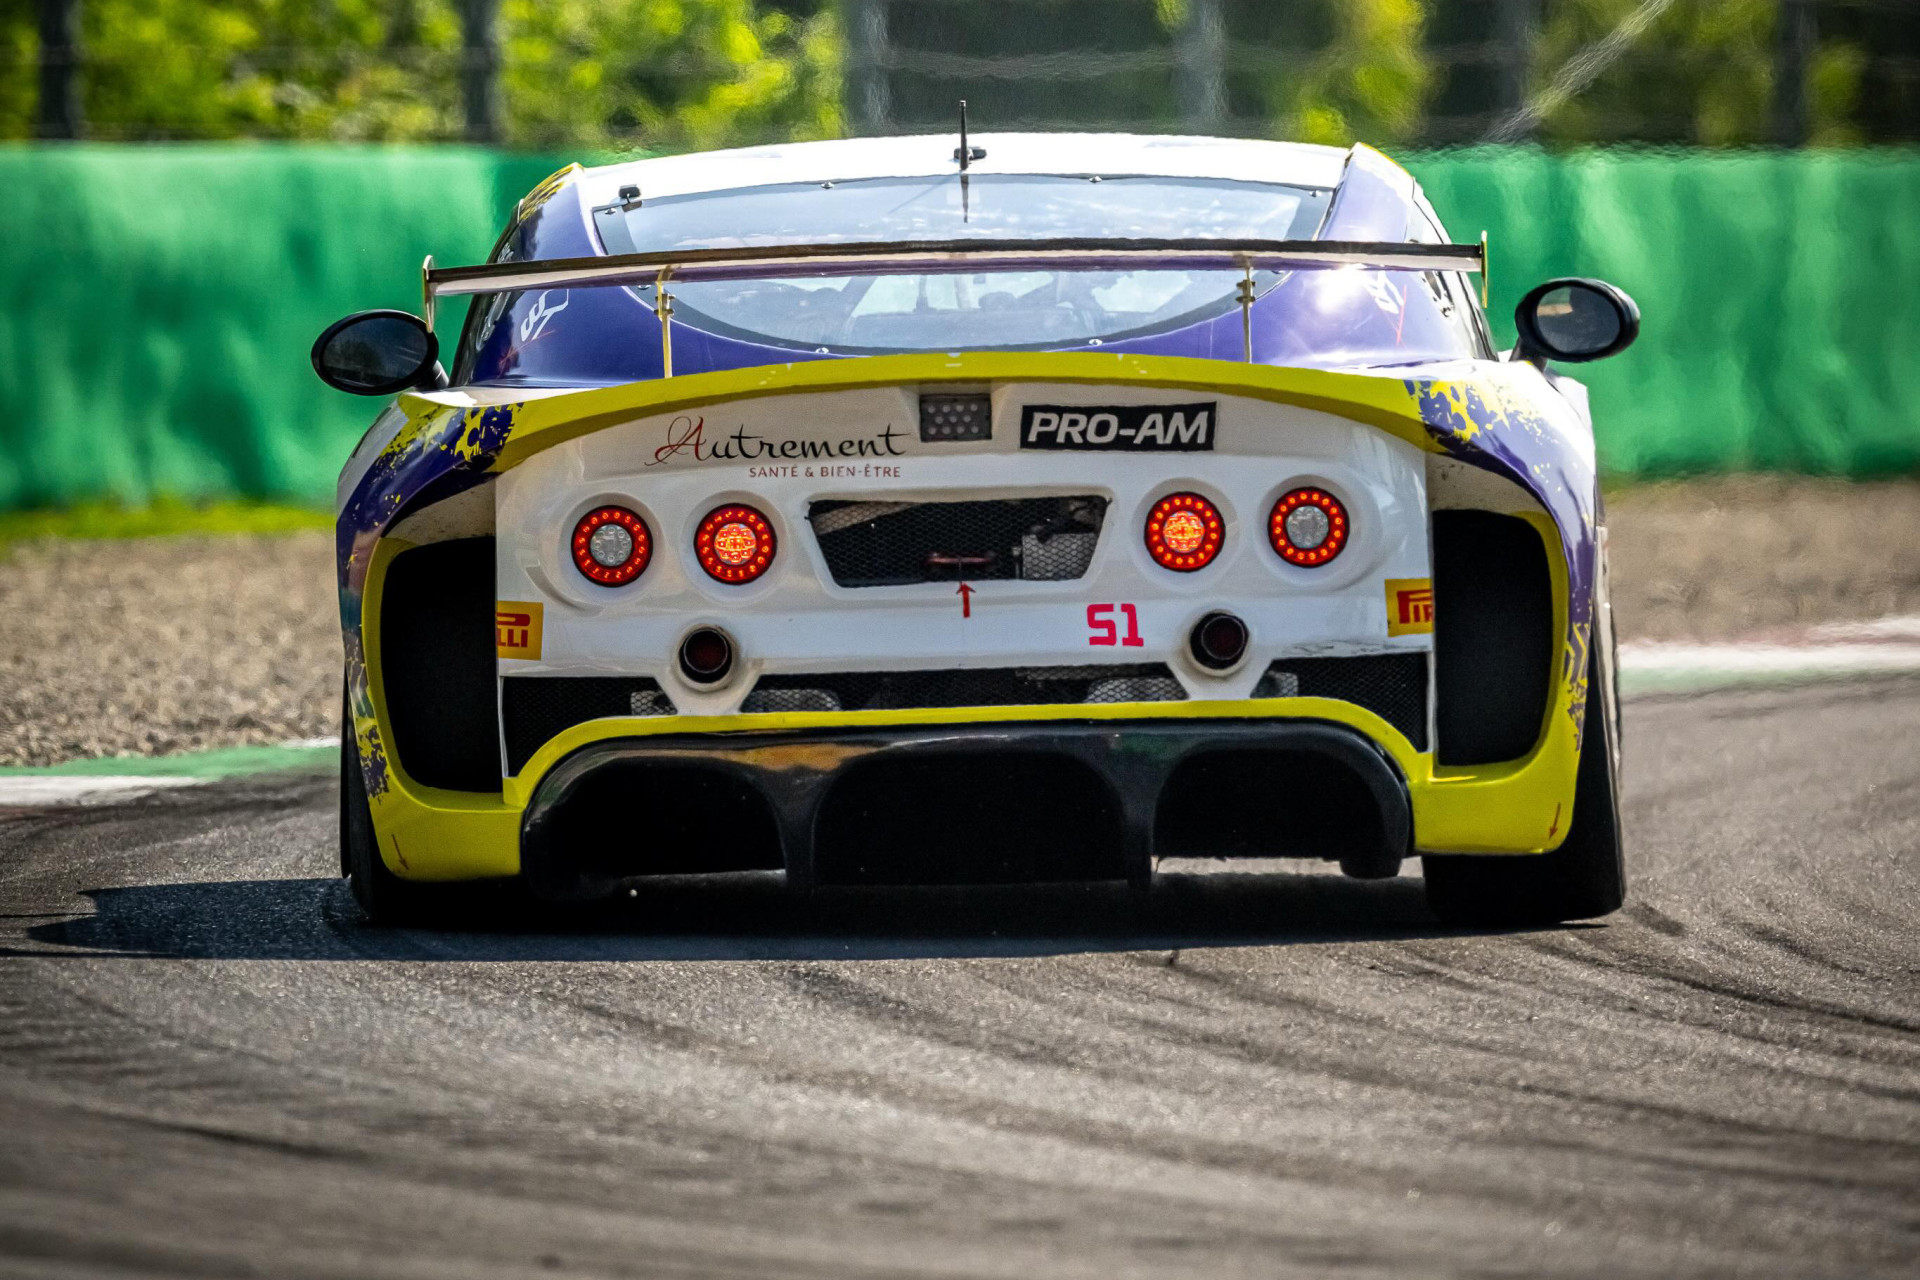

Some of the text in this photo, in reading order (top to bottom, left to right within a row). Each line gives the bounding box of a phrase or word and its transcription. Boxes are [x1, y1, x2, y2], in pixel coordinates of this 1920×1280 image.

[644, 416, 911, 467] Autrement
[1027, 411, 1209, 445] PRO-AM
[749, 464, 901, 478] SANTÉ & BIEN-ÊTRE
